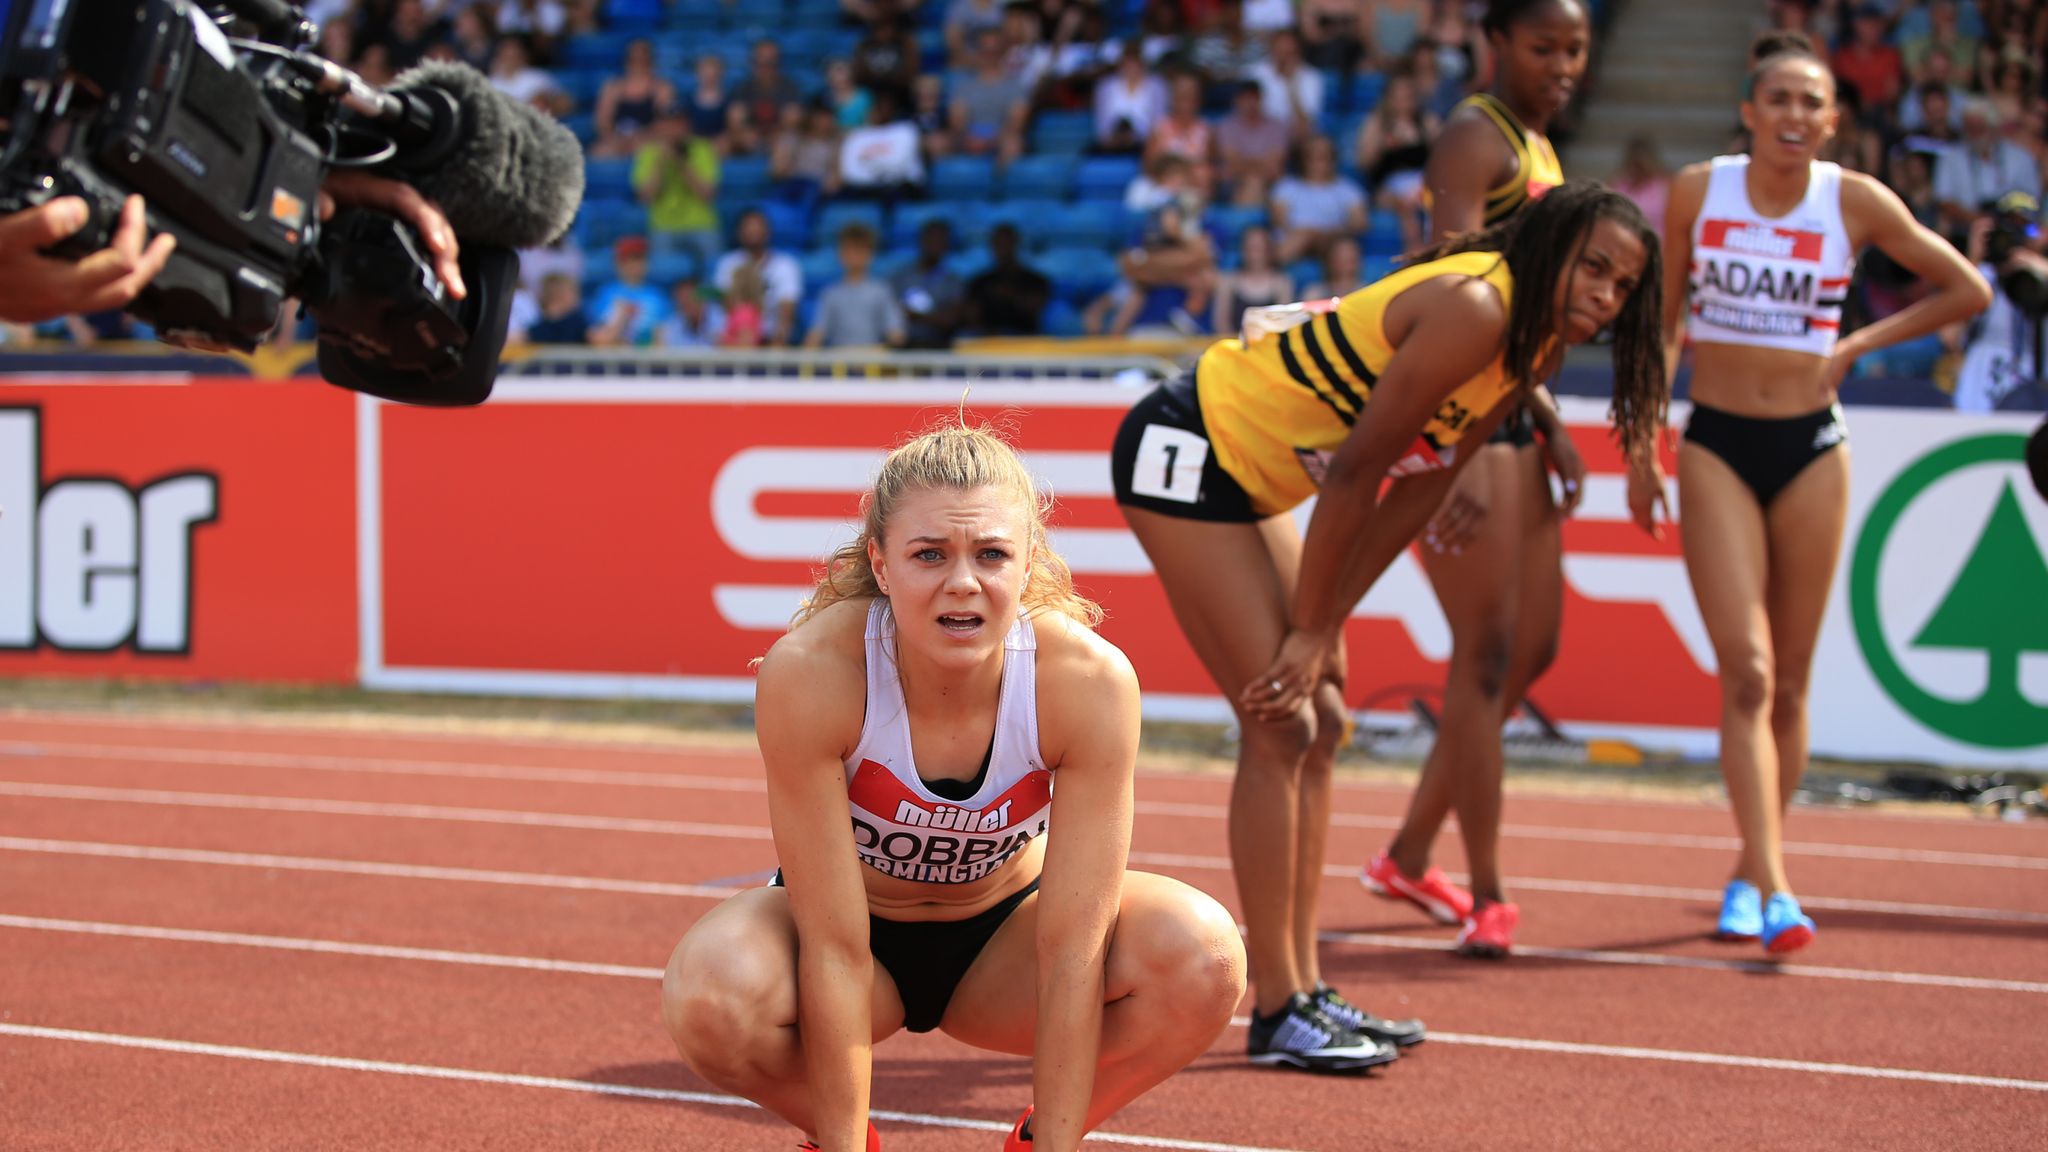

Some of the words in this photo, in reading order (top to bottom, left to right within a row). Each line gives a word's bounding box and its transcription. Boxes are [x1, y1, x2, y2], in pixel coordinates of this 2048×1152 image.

[1702, 259, 1814, 306] ADAM
[1163, 445, 1178, 490] 1
[894, 798, 1013, 834] müller
